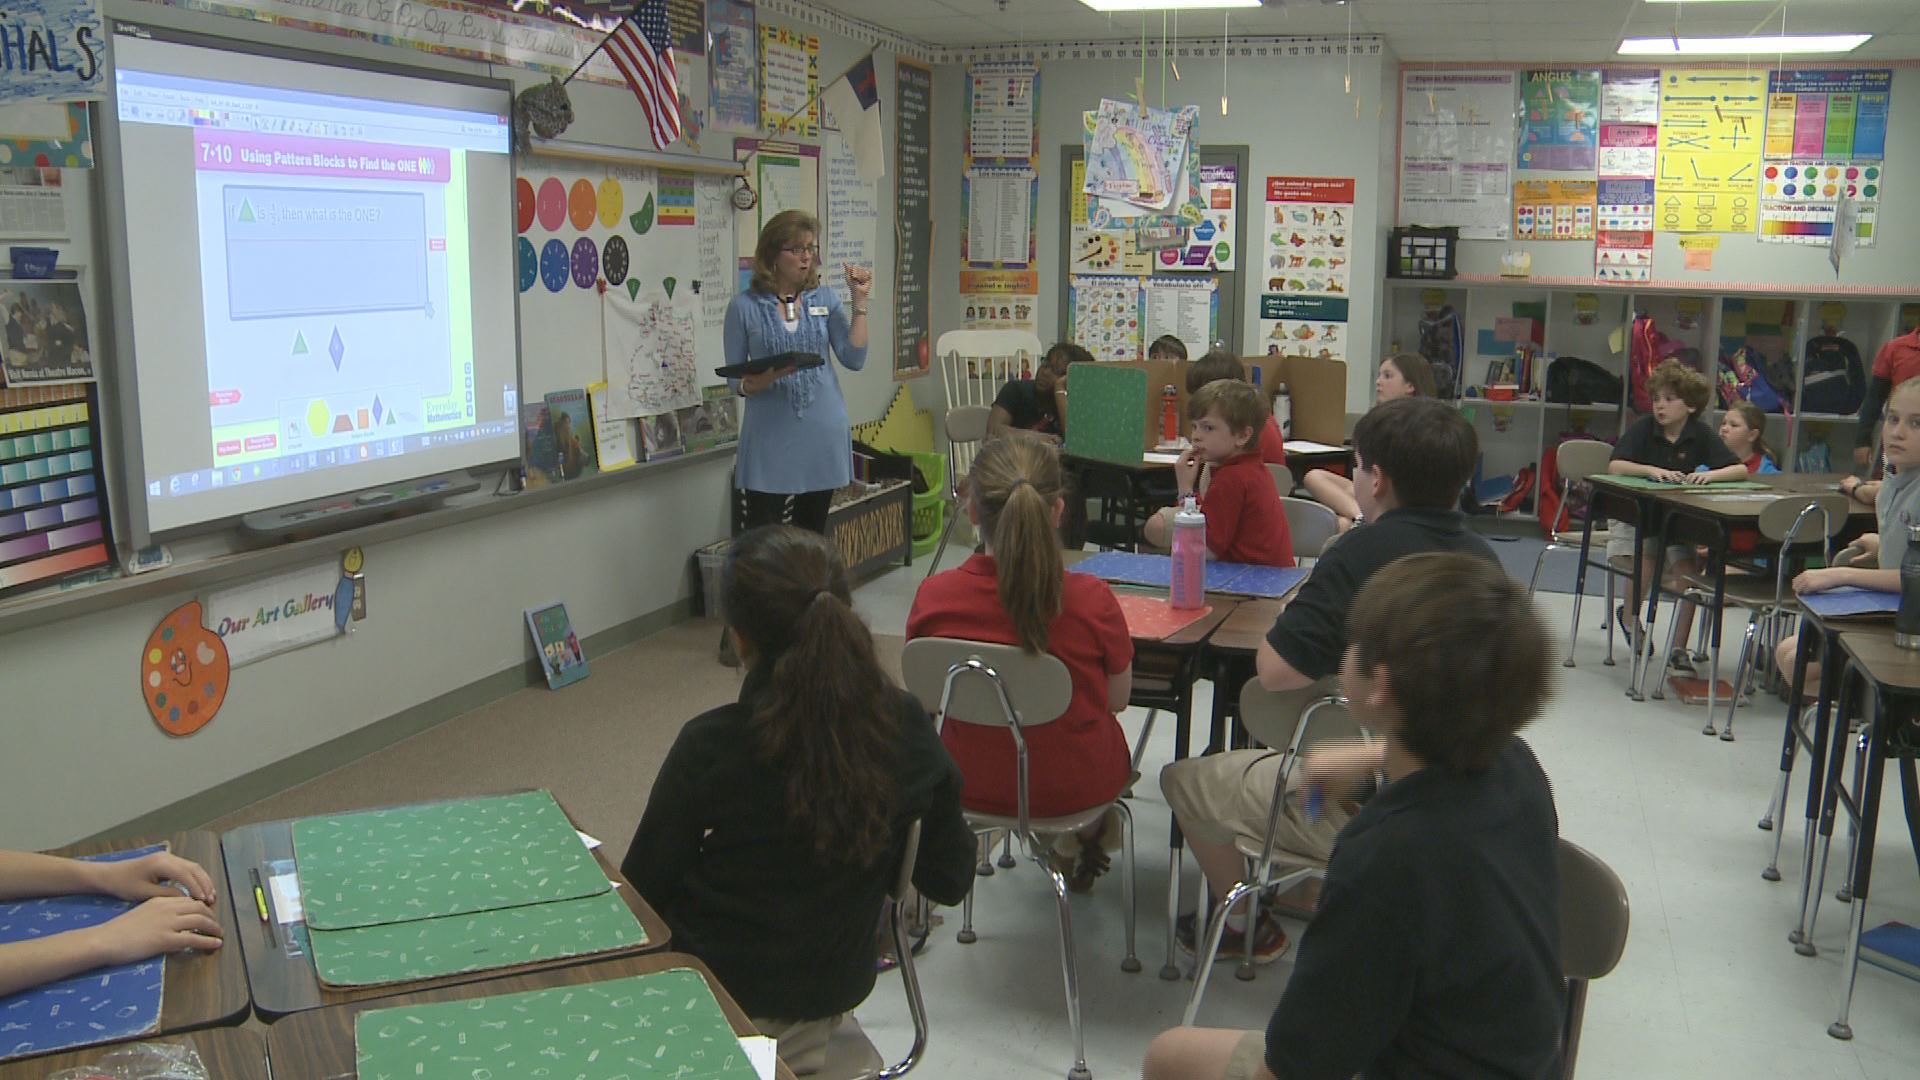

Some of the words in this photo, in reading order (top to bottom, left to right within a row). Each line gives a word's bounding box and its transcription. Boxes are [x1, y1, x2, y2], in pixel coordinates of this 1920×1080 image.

[0, 24, 96, 81] HALS
[1101, 49, 1112, 58] 100
[1117, 49, 1127, 58] 101
[1147, 49, 1158, 57] 103
[1208, 46, 1220, 56] 107
[1240, 46, 1252, 57] 109
[1256, 46, 1268, 56] 110
[1272, 46, 1283, 56] 111
[1288, 45, 1299, 56] 112
[1304, 45, 1315, 55] 113
[1320, 45, 1331, 55] 114
[1336, 45, 1347, 55] 115
[1368, 44, 1380, 55] 117
[1532, 71, 1572, 83] ANGLES
[240, 148, 273, 166] Using
[274, 150, 312, 167] Pattern
[313, 153, 346, 169] Blocks
[347, 156, 358, 169] to
[360, 157, 380, 171] Find
[381, 158, 396, 171] the
[397, 159, 417, 172] ONE
[218, 616, 250, 638] Our
[252, 606, 280, 628] Art
[283, 592, 335, 619] Gallery
